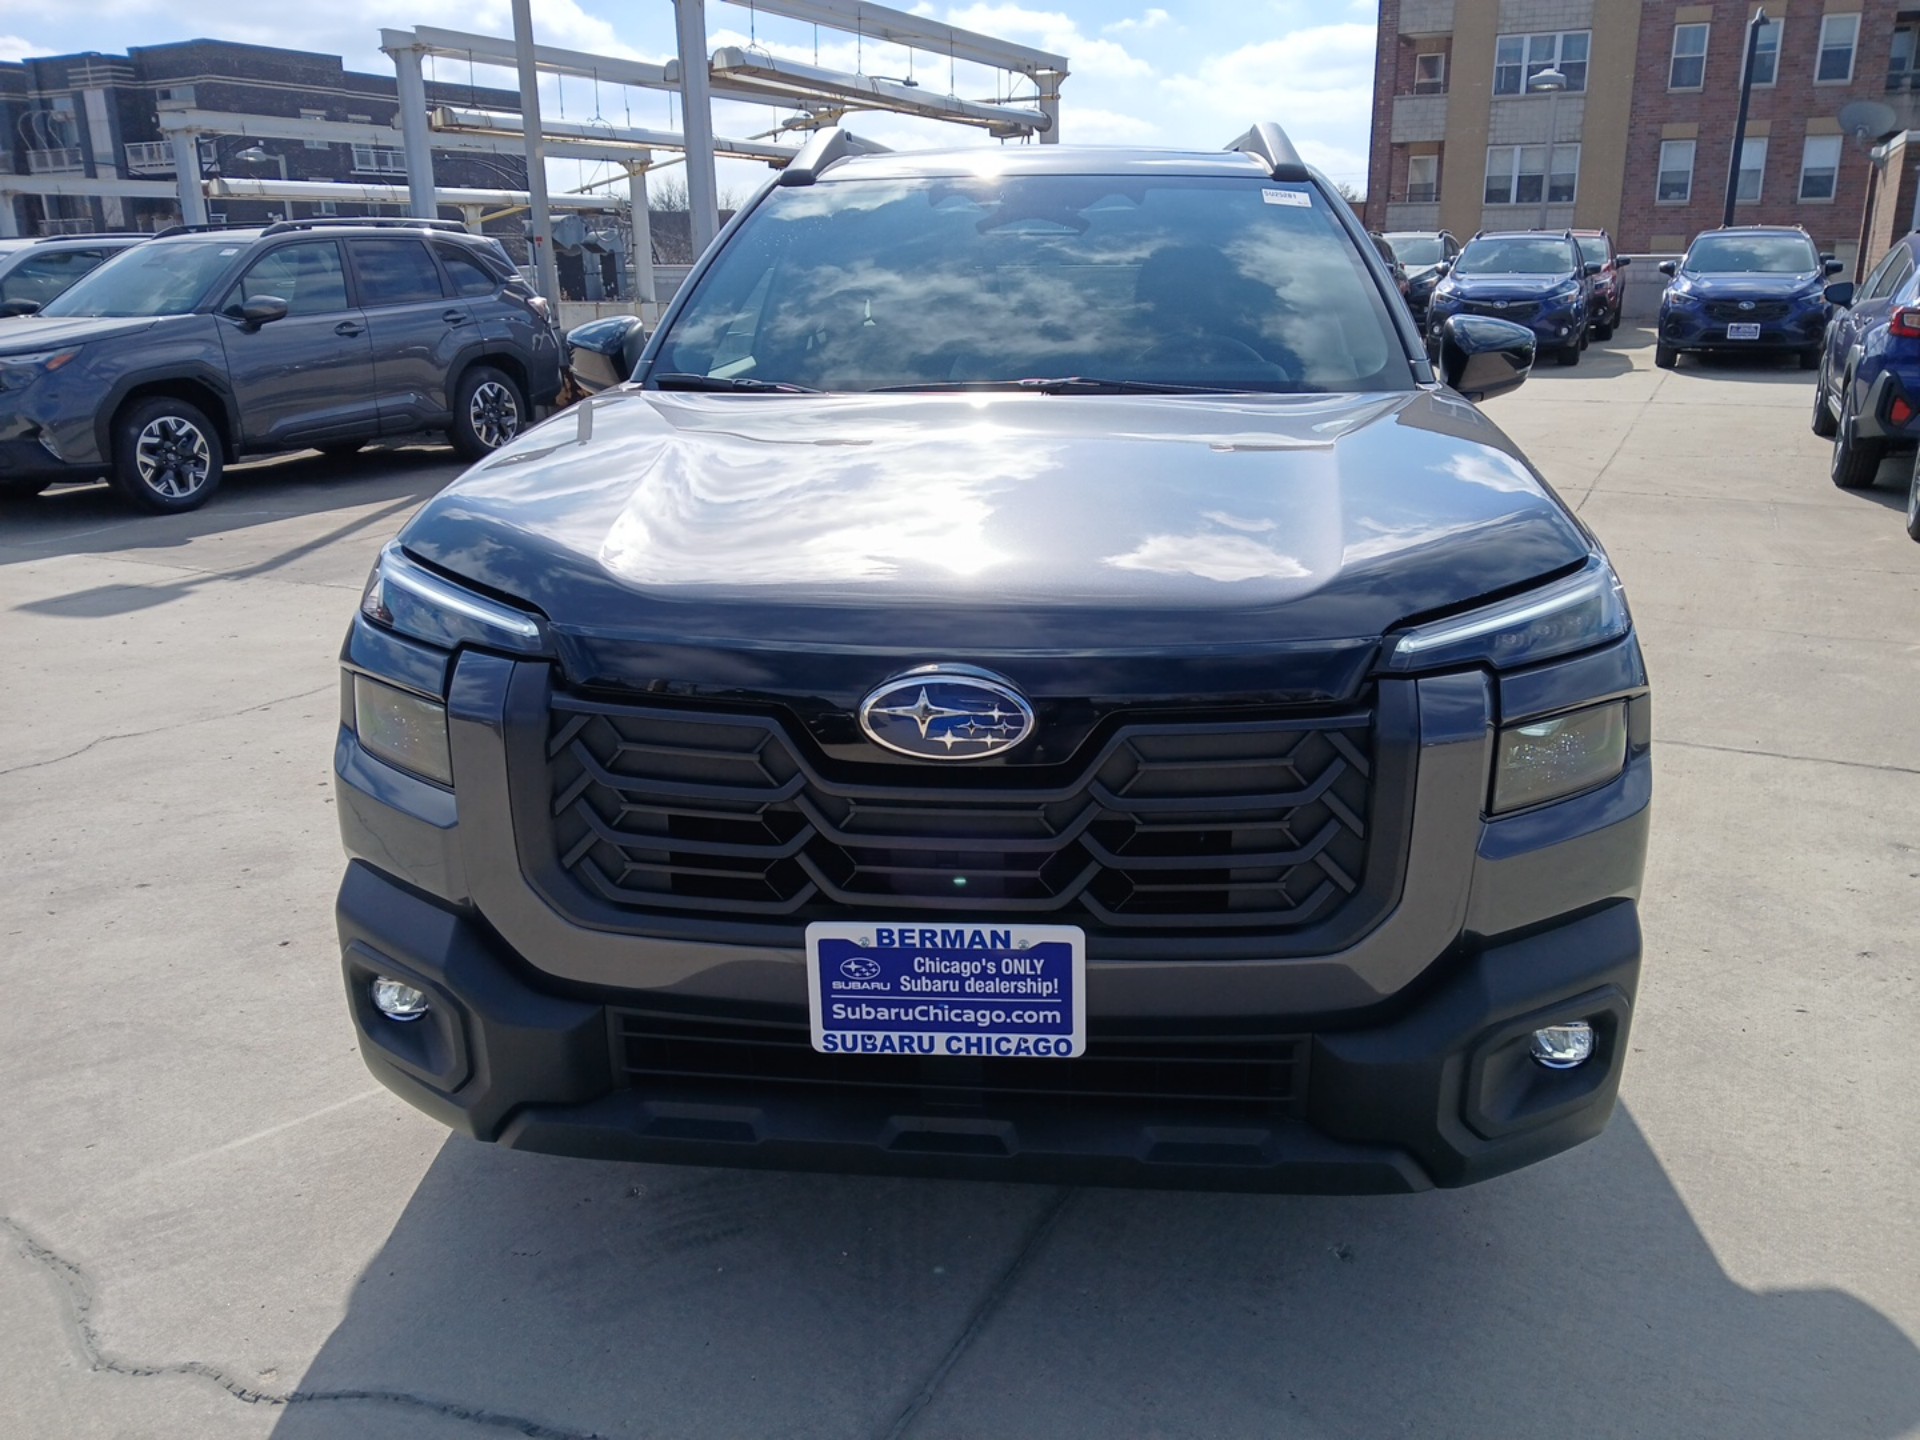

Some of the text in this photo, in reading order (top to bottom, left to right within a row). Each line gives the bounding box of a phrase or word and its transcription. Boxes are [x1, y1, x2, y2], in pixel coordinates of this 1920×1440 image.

[876, 928, 1011, 949] BERMAN
[914, 957, 1044, 977] Chicago's ONLY
[832, 981, 890, 991] SUBARU
[900, 976, 1059, 997] Subaru dealership!
[832, 1004, 1061, 1026] SubaruChicago.com
[822, 1034, 1073, 1057] SUBARU CHICAGO
